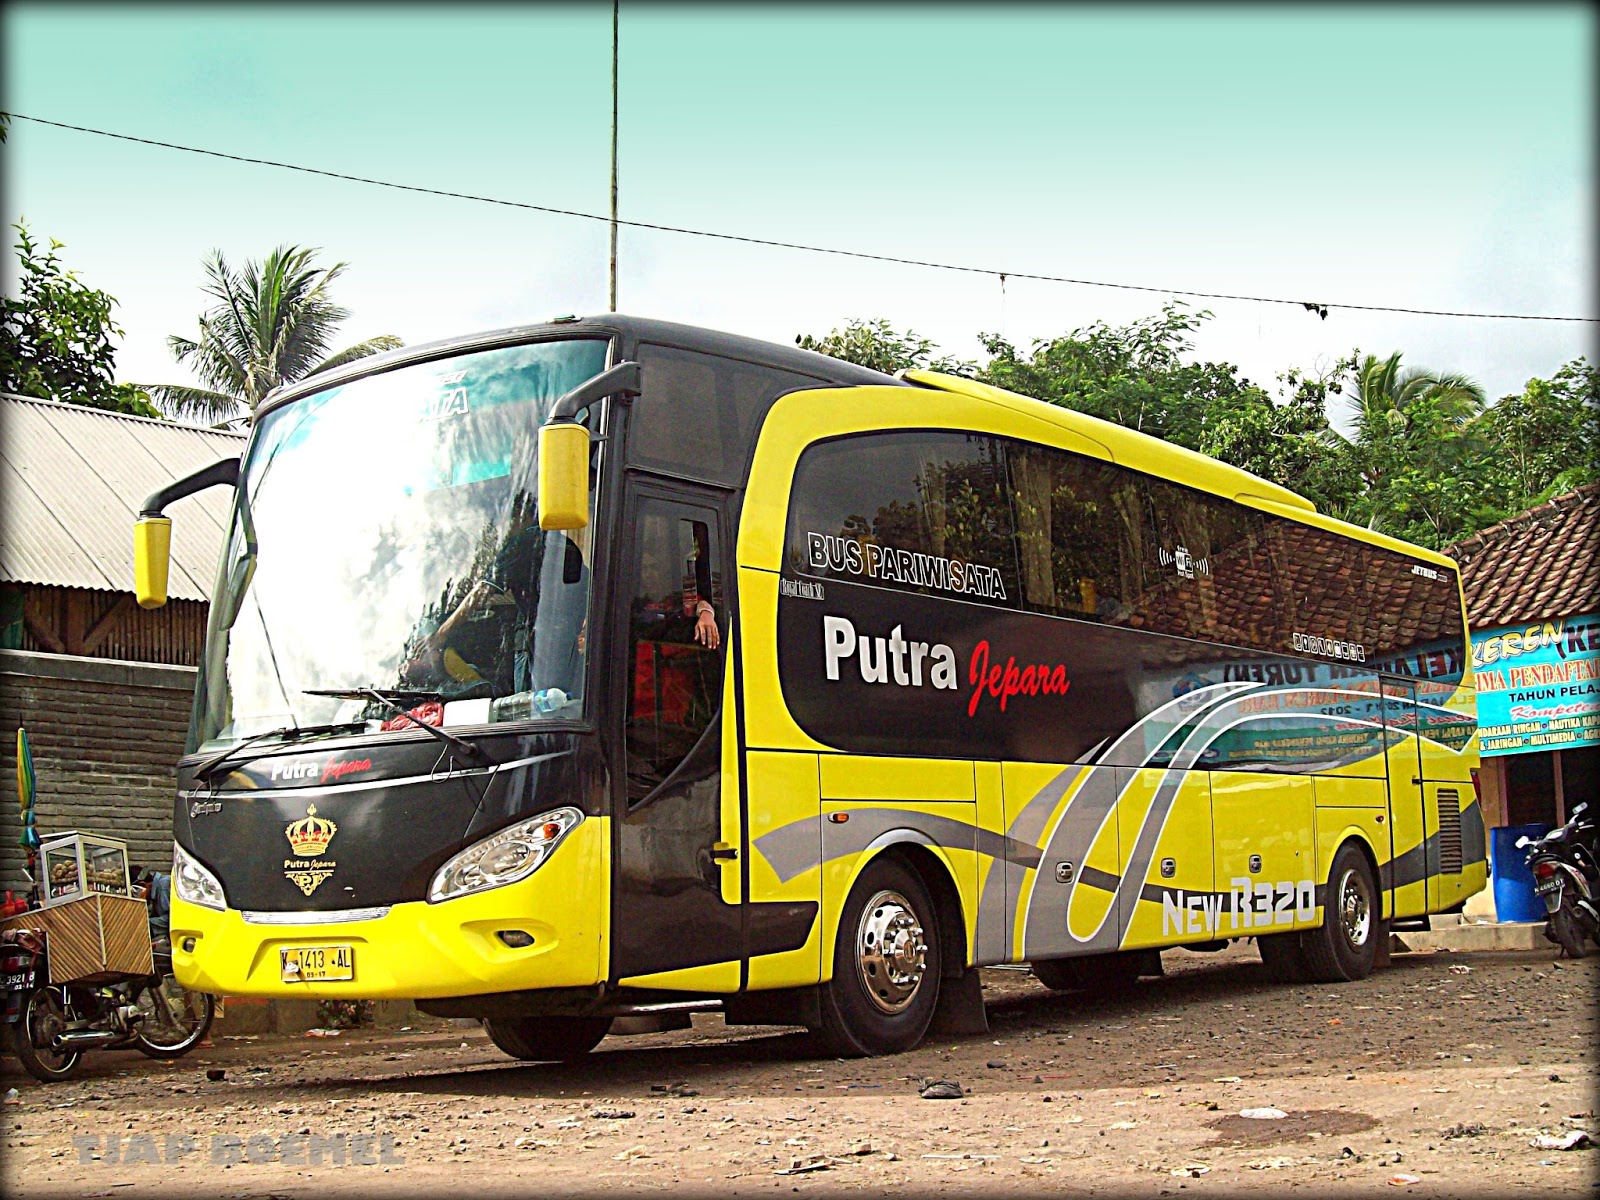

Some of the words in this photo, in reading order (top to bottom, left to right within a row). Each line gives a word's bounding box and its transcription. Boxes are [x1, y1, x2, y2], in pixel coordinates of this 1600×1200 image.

[807, 532, 864, 575] BUS
[866, 544, 1007, 600] PARIWISATA
[823, 615, 958, 690] Putra
[968, 640, 1070, 717] Jepara
[1509, 688, 1555, 703] TAHUN
[1513, 721, 1541, 734] RINGAN
[1549, 717, 1580, 730] NAUTIKA
[1487, 736, 1523, 750] JARINGAN
[1530, 731, 1576, 746] MULTIMEDIA
[270, 760, 319, 780] Putra
[320, 756, 372, 783] Jepara
[284, 859, 310, 868] Putra
[1230, 877, 1315, 929] R320
[299, 950, 325, 969] 1413
[338, 949, 351, 968] AL
